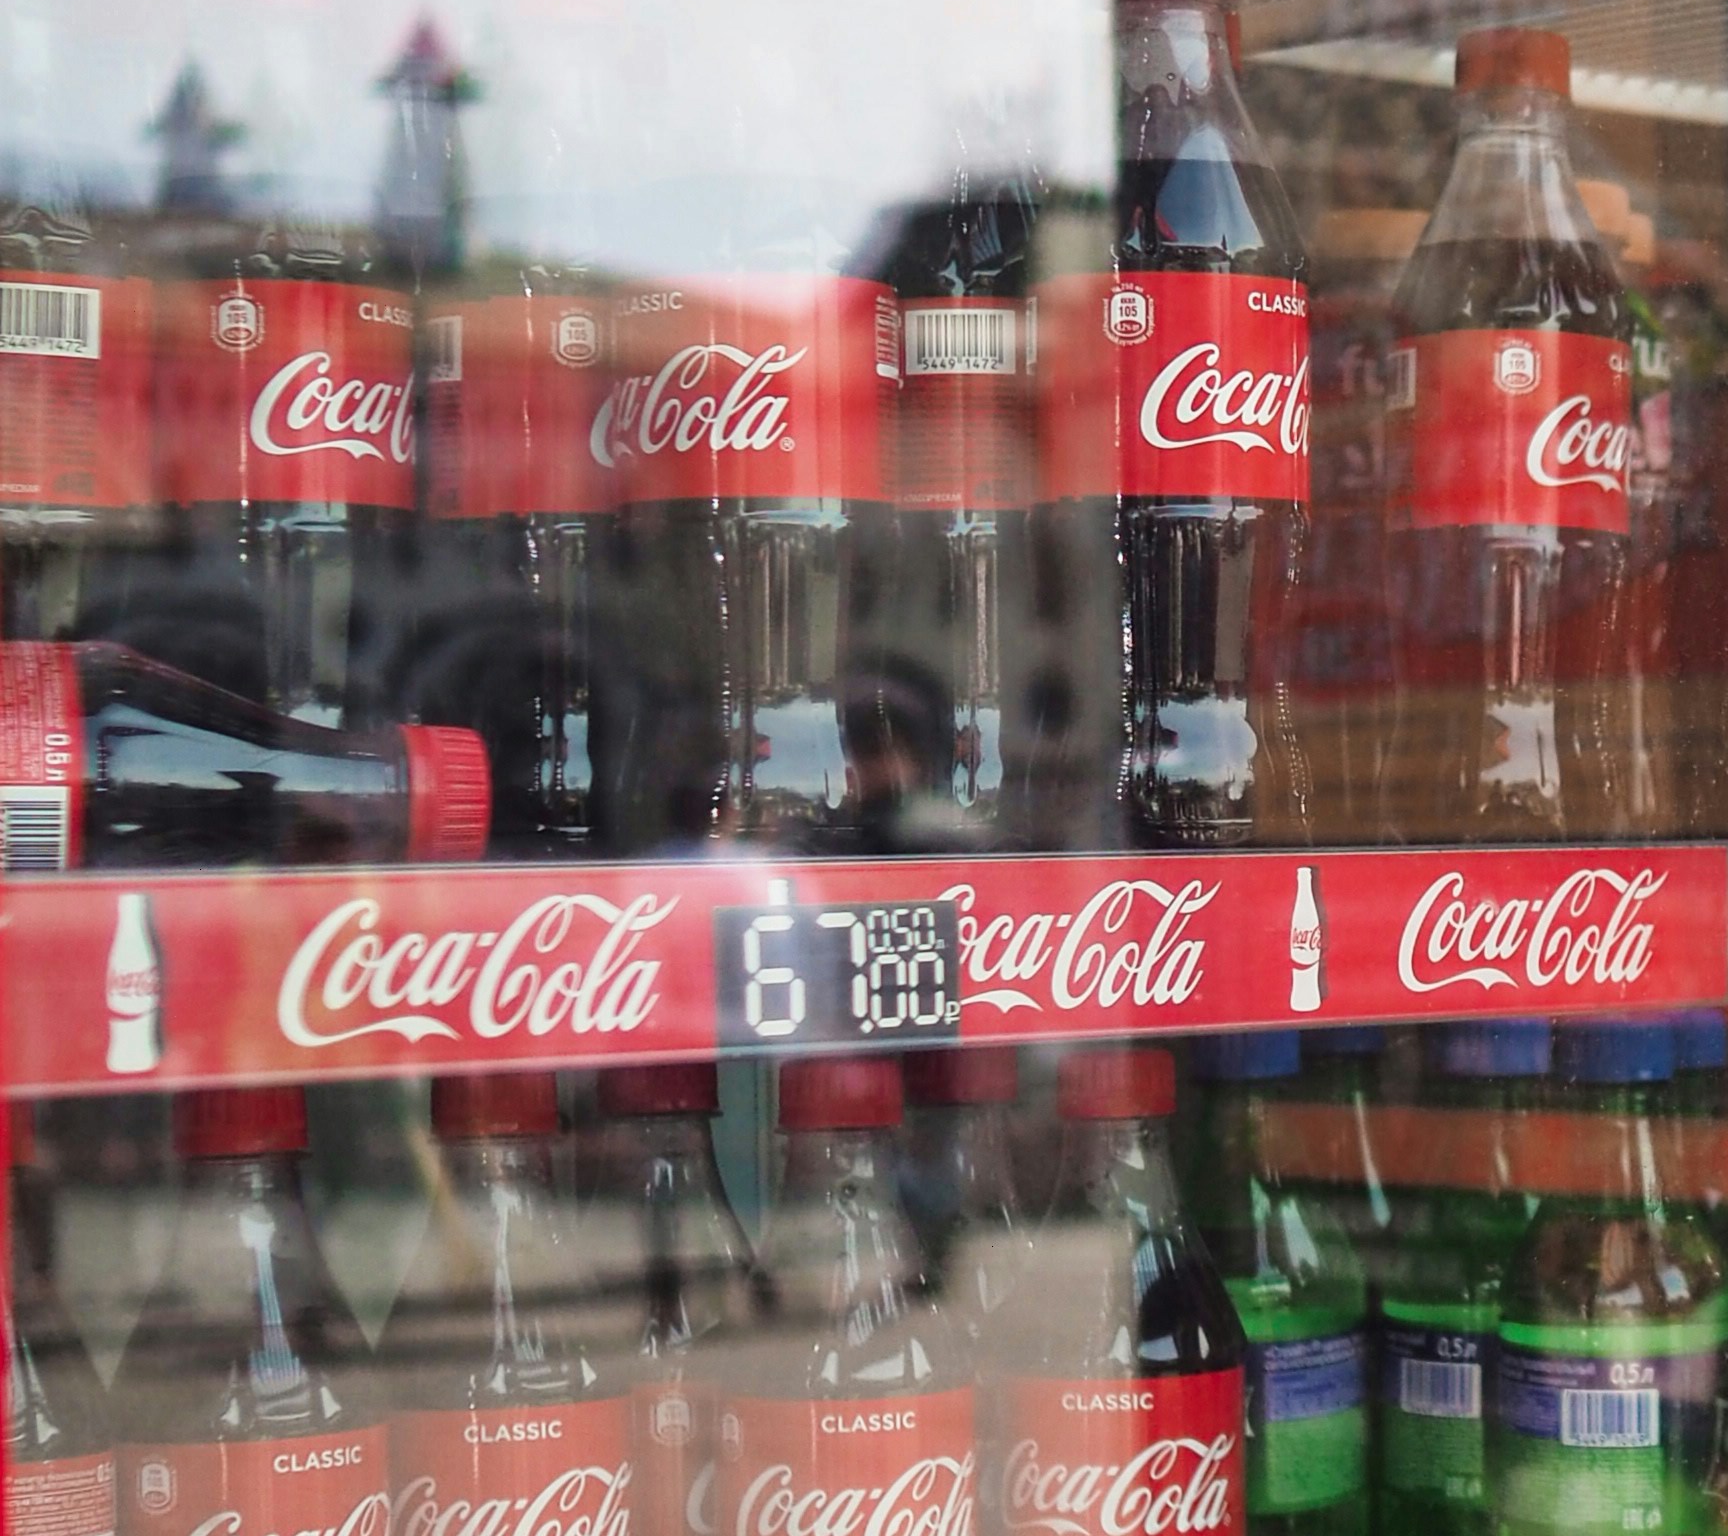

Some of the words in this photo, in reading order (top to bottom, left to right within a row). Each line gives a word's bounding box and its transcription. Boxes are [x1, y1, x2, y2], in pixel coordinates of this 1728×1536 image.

[1397, 867, 1669, 995] Coca-Cola
[938, 880, 1221, 1012] oca-Cola
[277, 894, 681, 1047] Coca-Cola
[1061, 1392, 1154, 1413] CLASSIC
[463, 1420, 563, 1444] CLASSIC
[821, 1411, 917, 1434] CLASSIC
[273, 1445, 363, 1474] CLASSIC
